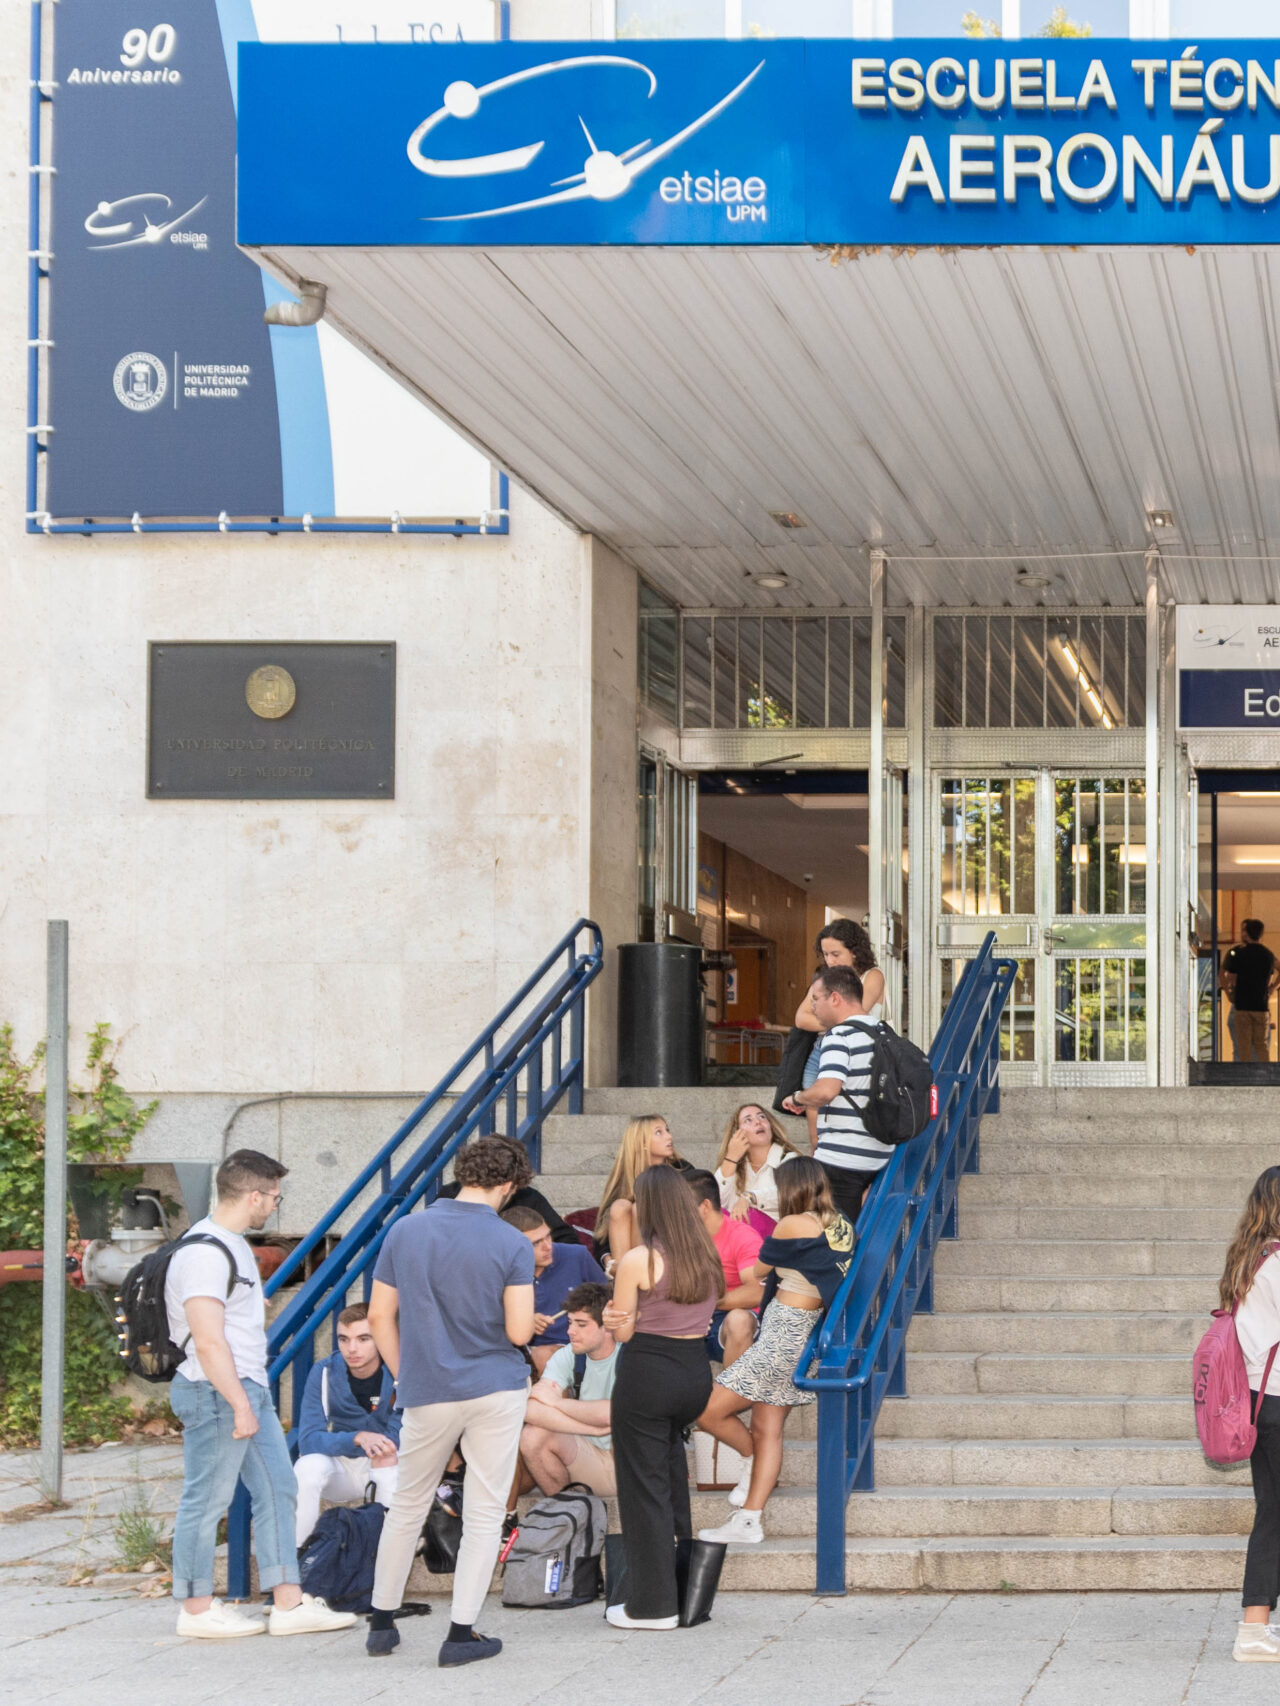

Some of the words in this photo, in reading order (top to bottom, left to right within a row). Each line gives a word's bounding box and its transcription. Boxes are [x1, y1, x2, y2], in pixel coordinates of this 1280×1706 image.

[120, 23, 176, 67] 90
[67, 67, 182, 84] Aniversario
[851, 56, 1118, 111] ESCUELA
[659, 169, 767, 203] etsiae
[726, 204, 767, 222] UPM
[184, 364, 250, 374] UNIVERSIDAD
[184, 374, 249, 385] POLITÉCNICA
[184, 387, 198, 397] DE
[200, 387, 239, 397] MADRID
